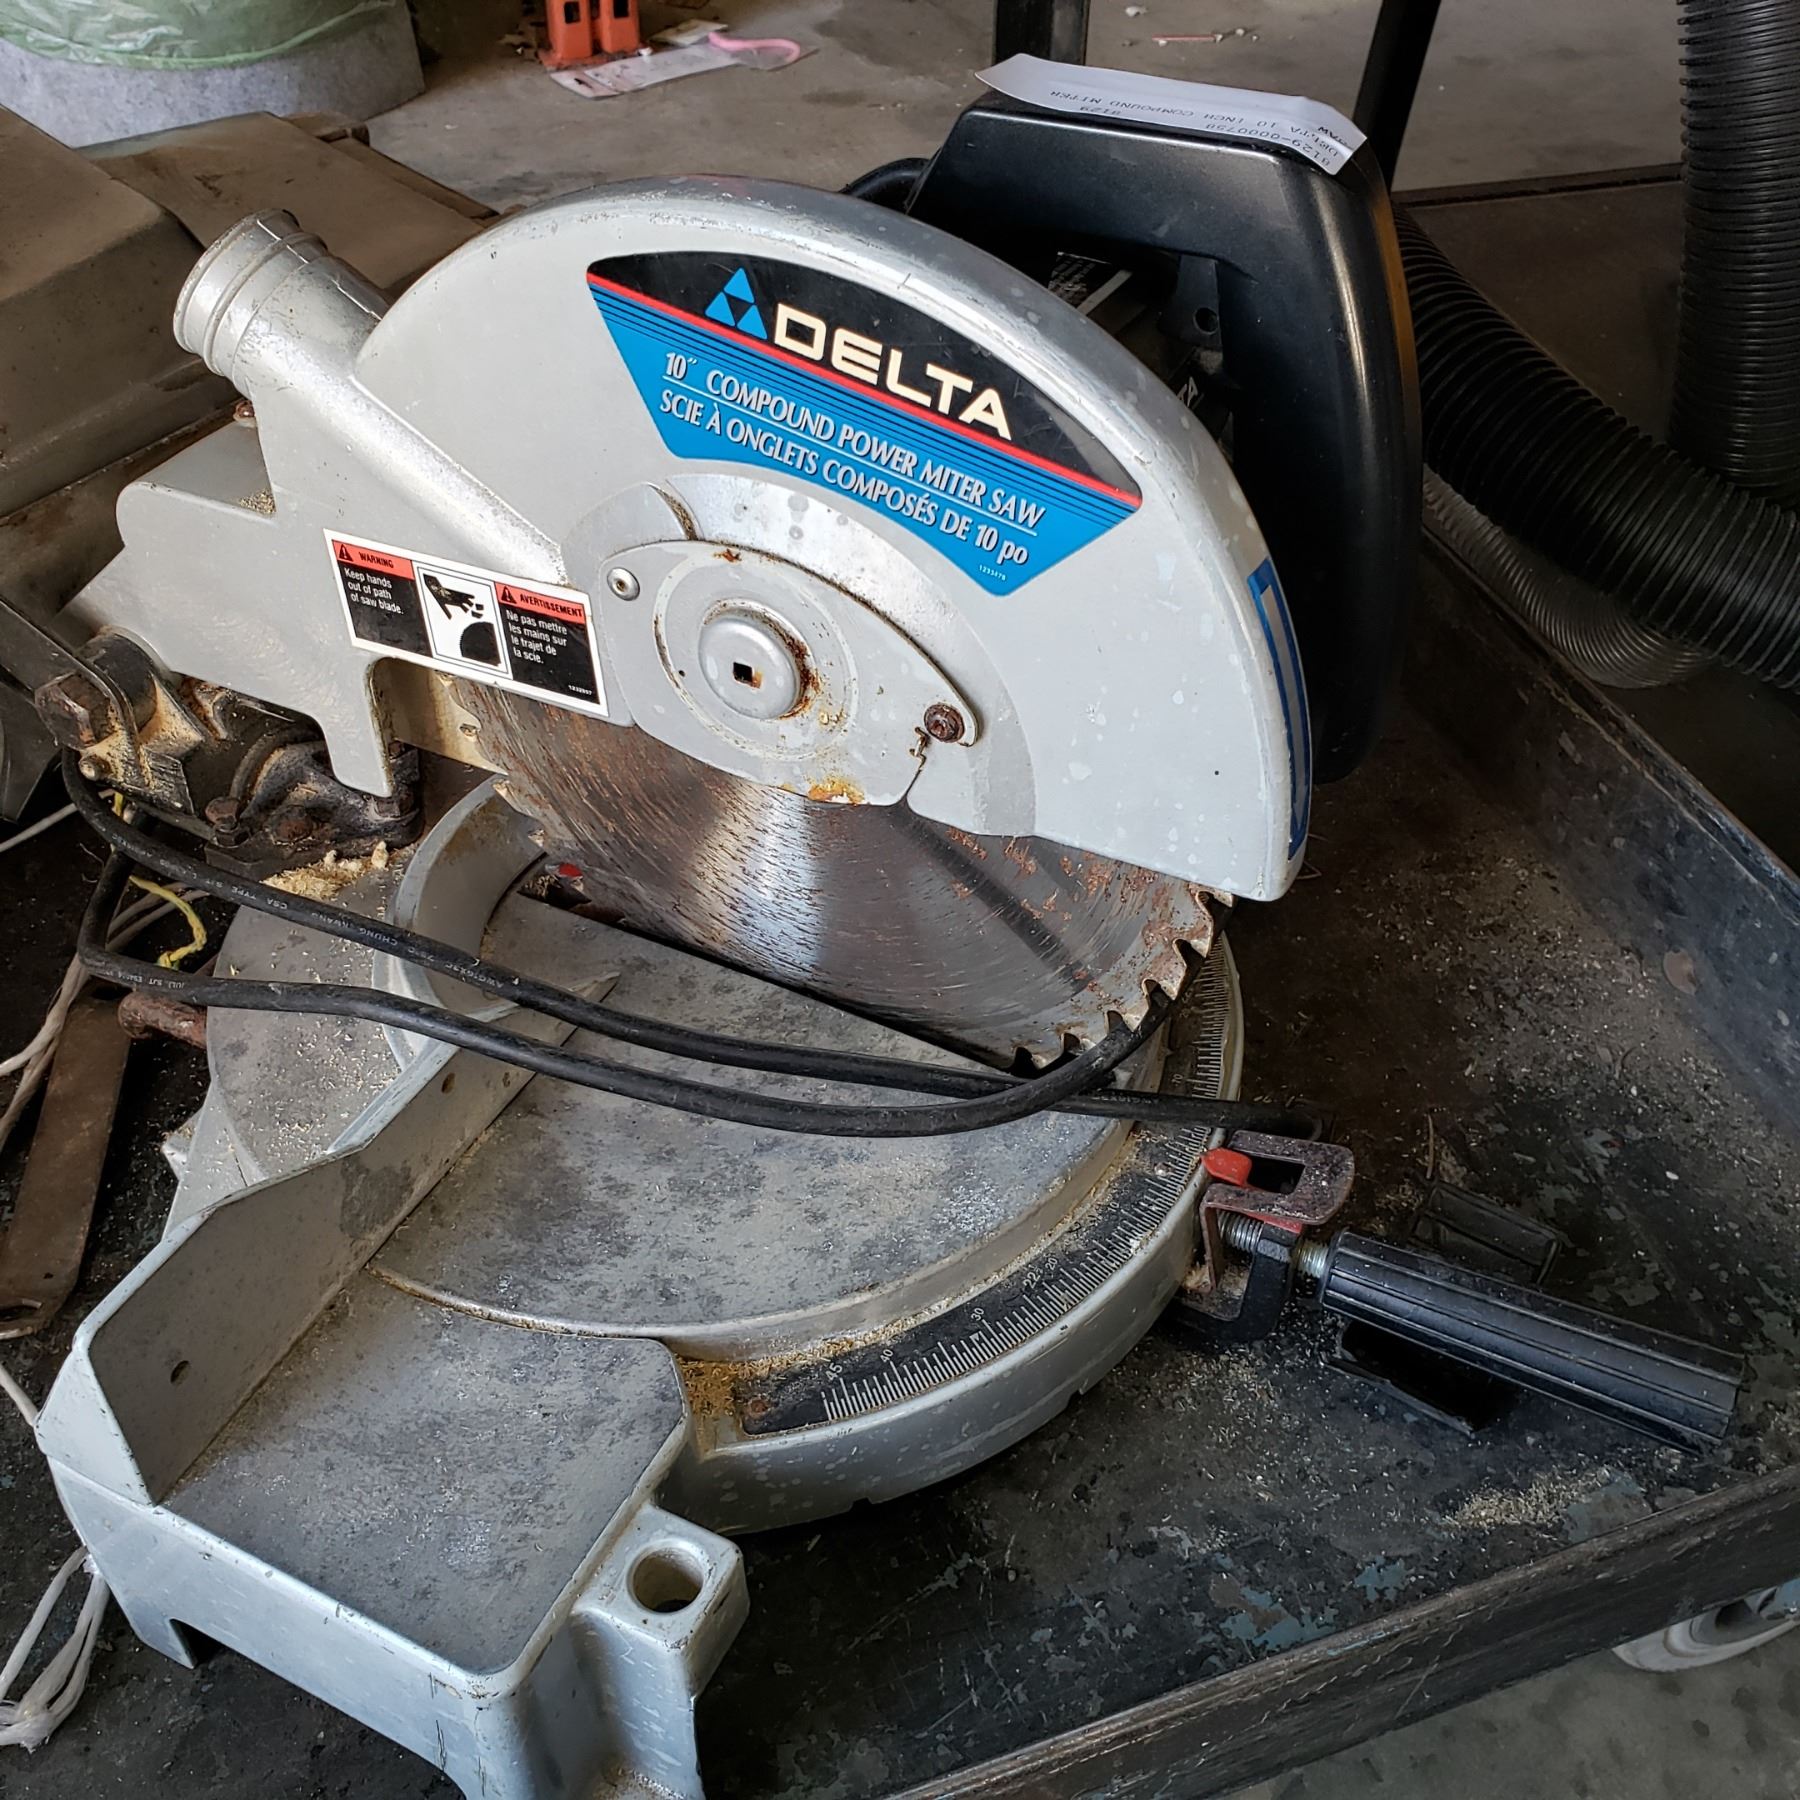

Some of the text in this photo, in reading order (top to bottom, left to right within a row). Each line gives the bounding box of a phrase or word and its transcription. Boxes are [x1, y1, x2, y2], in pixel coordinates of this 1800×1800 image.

[1050, 91, 1101, 104] MITER
[1110, 101, 1194, 116] COMPOUND
[1203, 113, 1244, 123] INCH
[774, 302, 1011, 441] DELTA
[706, 369, 835, 441] COMPOUND
[837, 424, 917, 478] POWER
[919, 459, 987, 507] MITER
[988, 488, 1046, 529] SAW
[660, 389, 1028, 565] SCIE À ONGLETS COMPOSÉS DE 10 po
[358, 552, 394, 568] WARNING
[344, 567, 392, 588] Keep hands
[348, 581, 392, 600] out of path
[350, 592, 404, 614] of saw blade.
[520, 593, 582, 617] AVERTISSEMENT
[506, 609, 567, 635] Ne pas mettre
[509, 623, 567, 647] les mains sur
[511, 635, 557, 656] le trajet de
[513, 647, 544, 664] la scie.
[231, 886, 256, 901] TYPE
[267, 898, 288, 910] CSA
[359, 927, 399, 946] CHUNG
[1047, 1257, 1058, 1272] 20
[970, 1307, 985, 1322] 30
[880, 1348, 894, 1364] 40
[825, 1361, 843, 1382] 45
